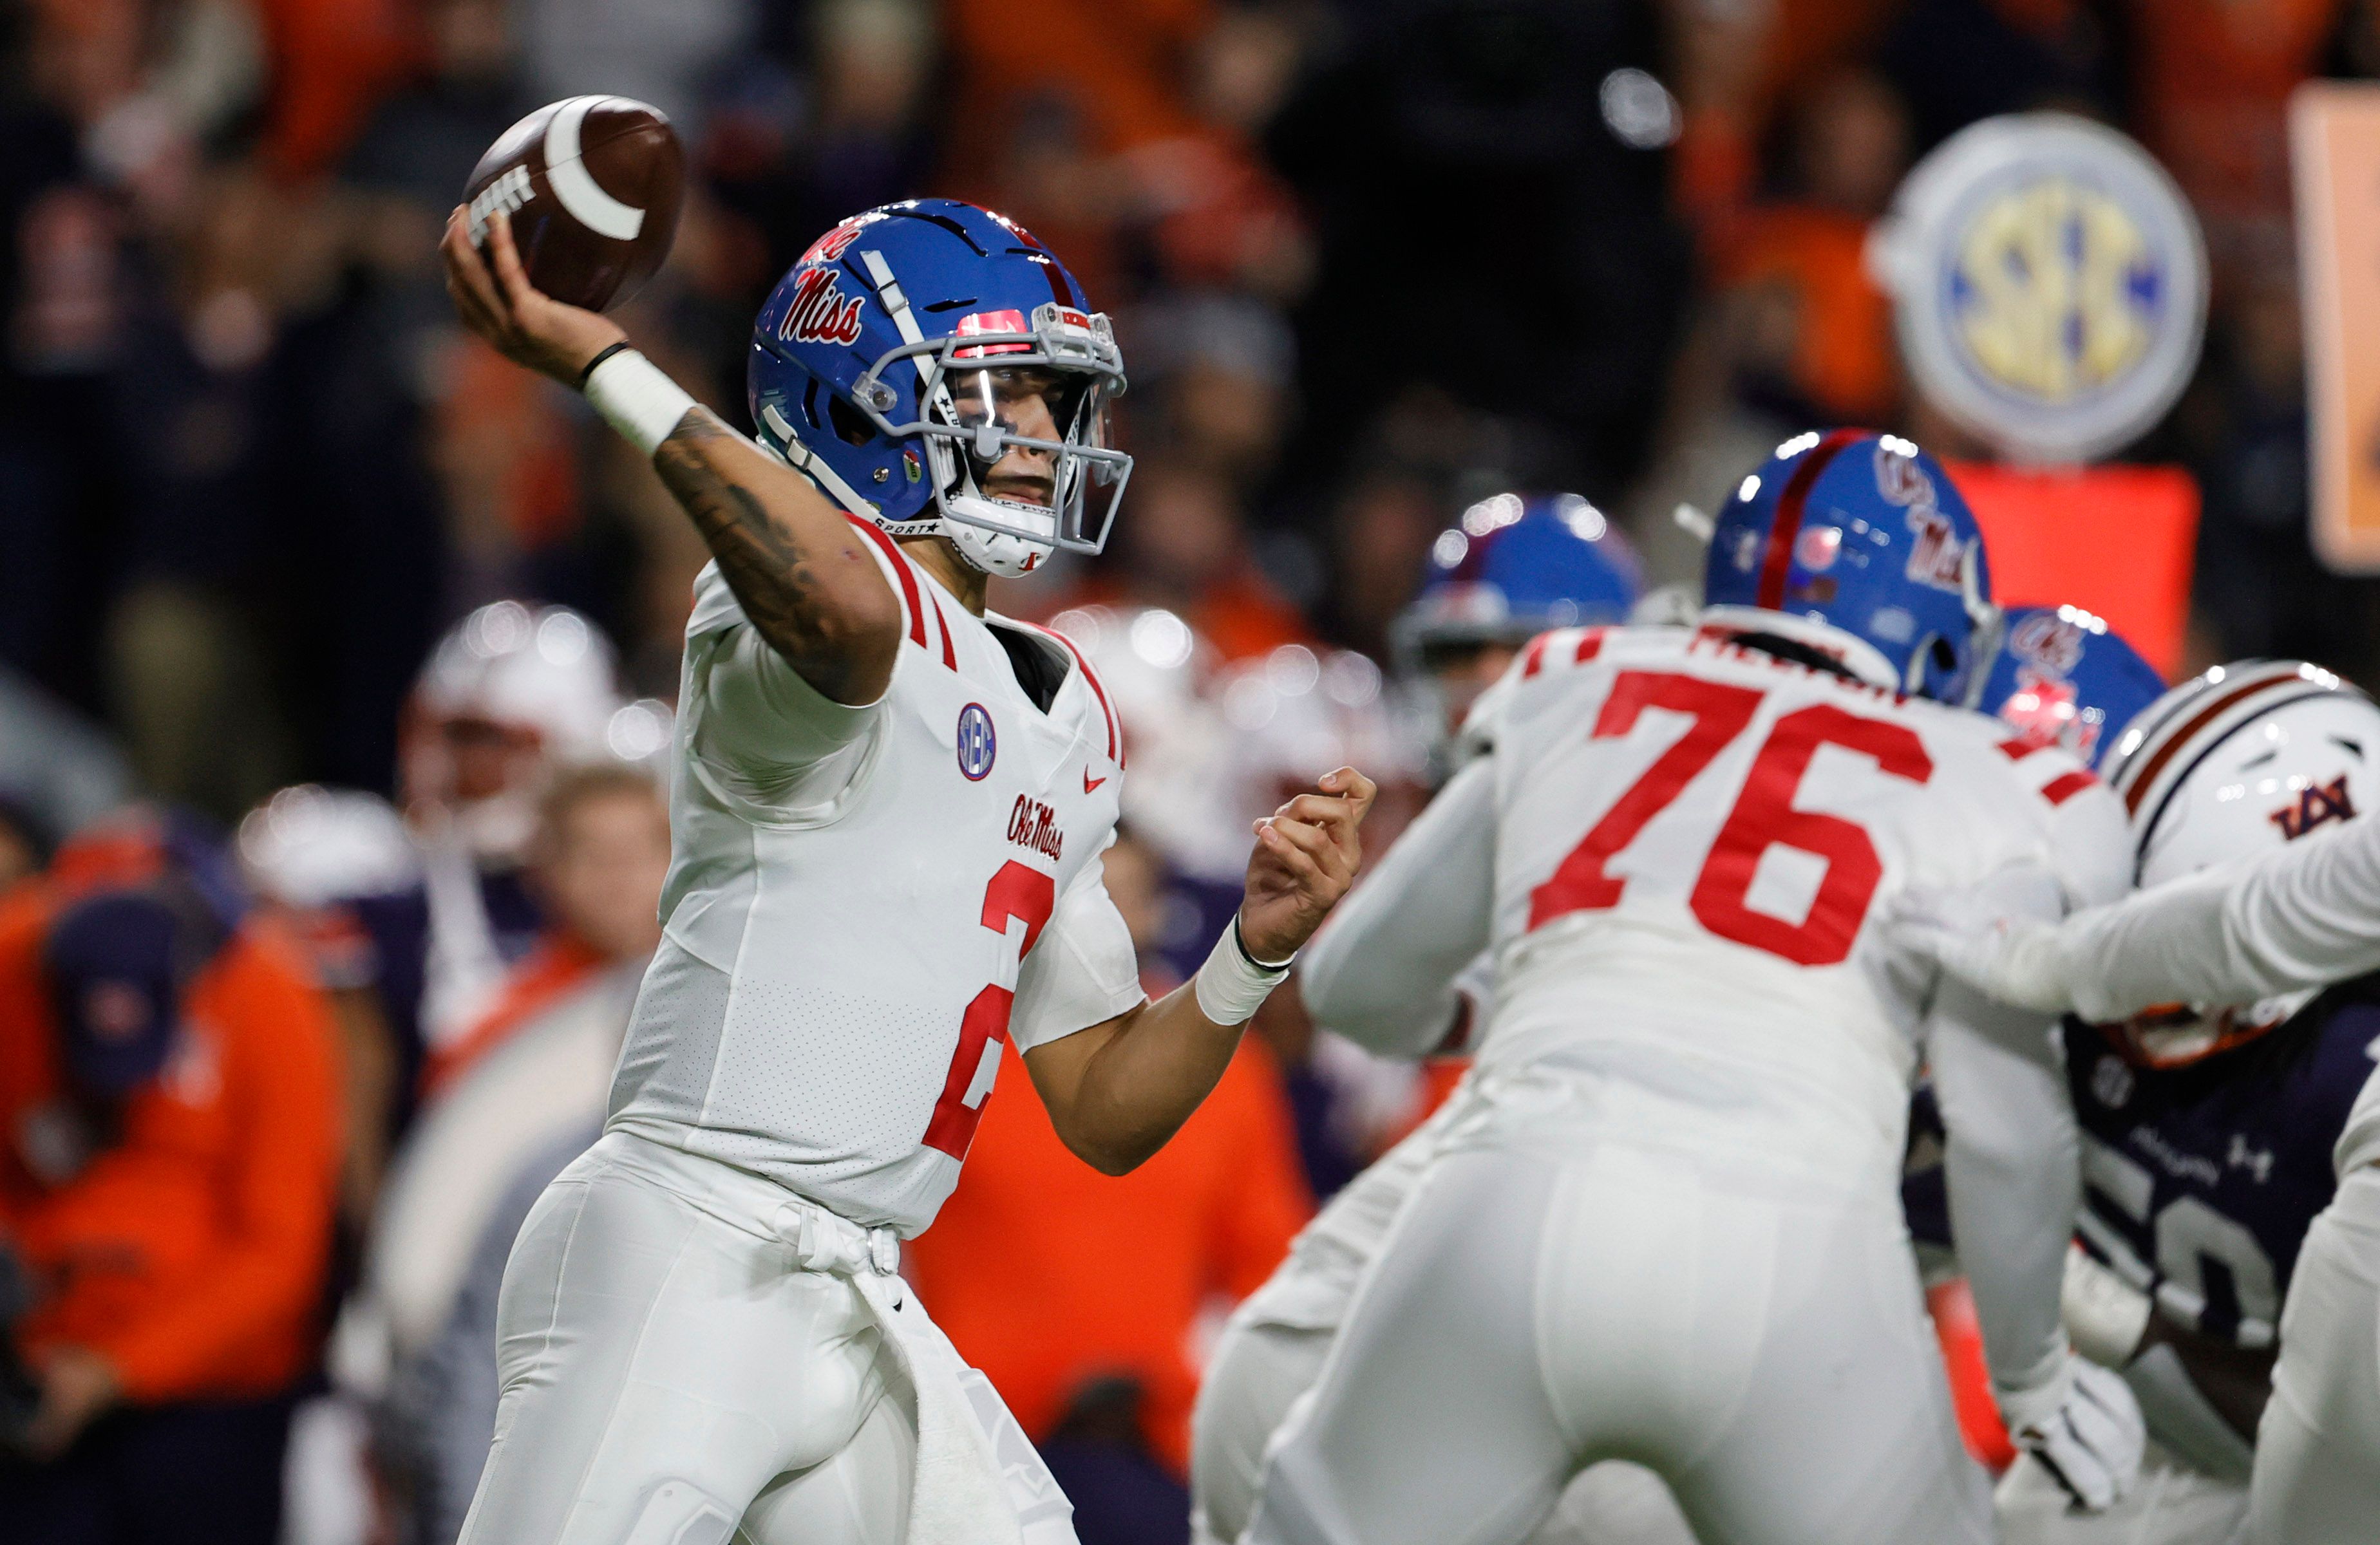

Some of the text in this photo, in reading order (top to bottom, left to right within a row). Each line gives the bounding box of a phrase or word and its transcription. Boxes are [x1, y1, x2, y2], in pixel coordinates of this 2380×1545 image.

[778, 265, 866, 346] Miss
[874, 518, 926, 534] SPORT
[1006, 792, 1064, 861] Ole Miss
[1525, 670, 1934, 968] 76
